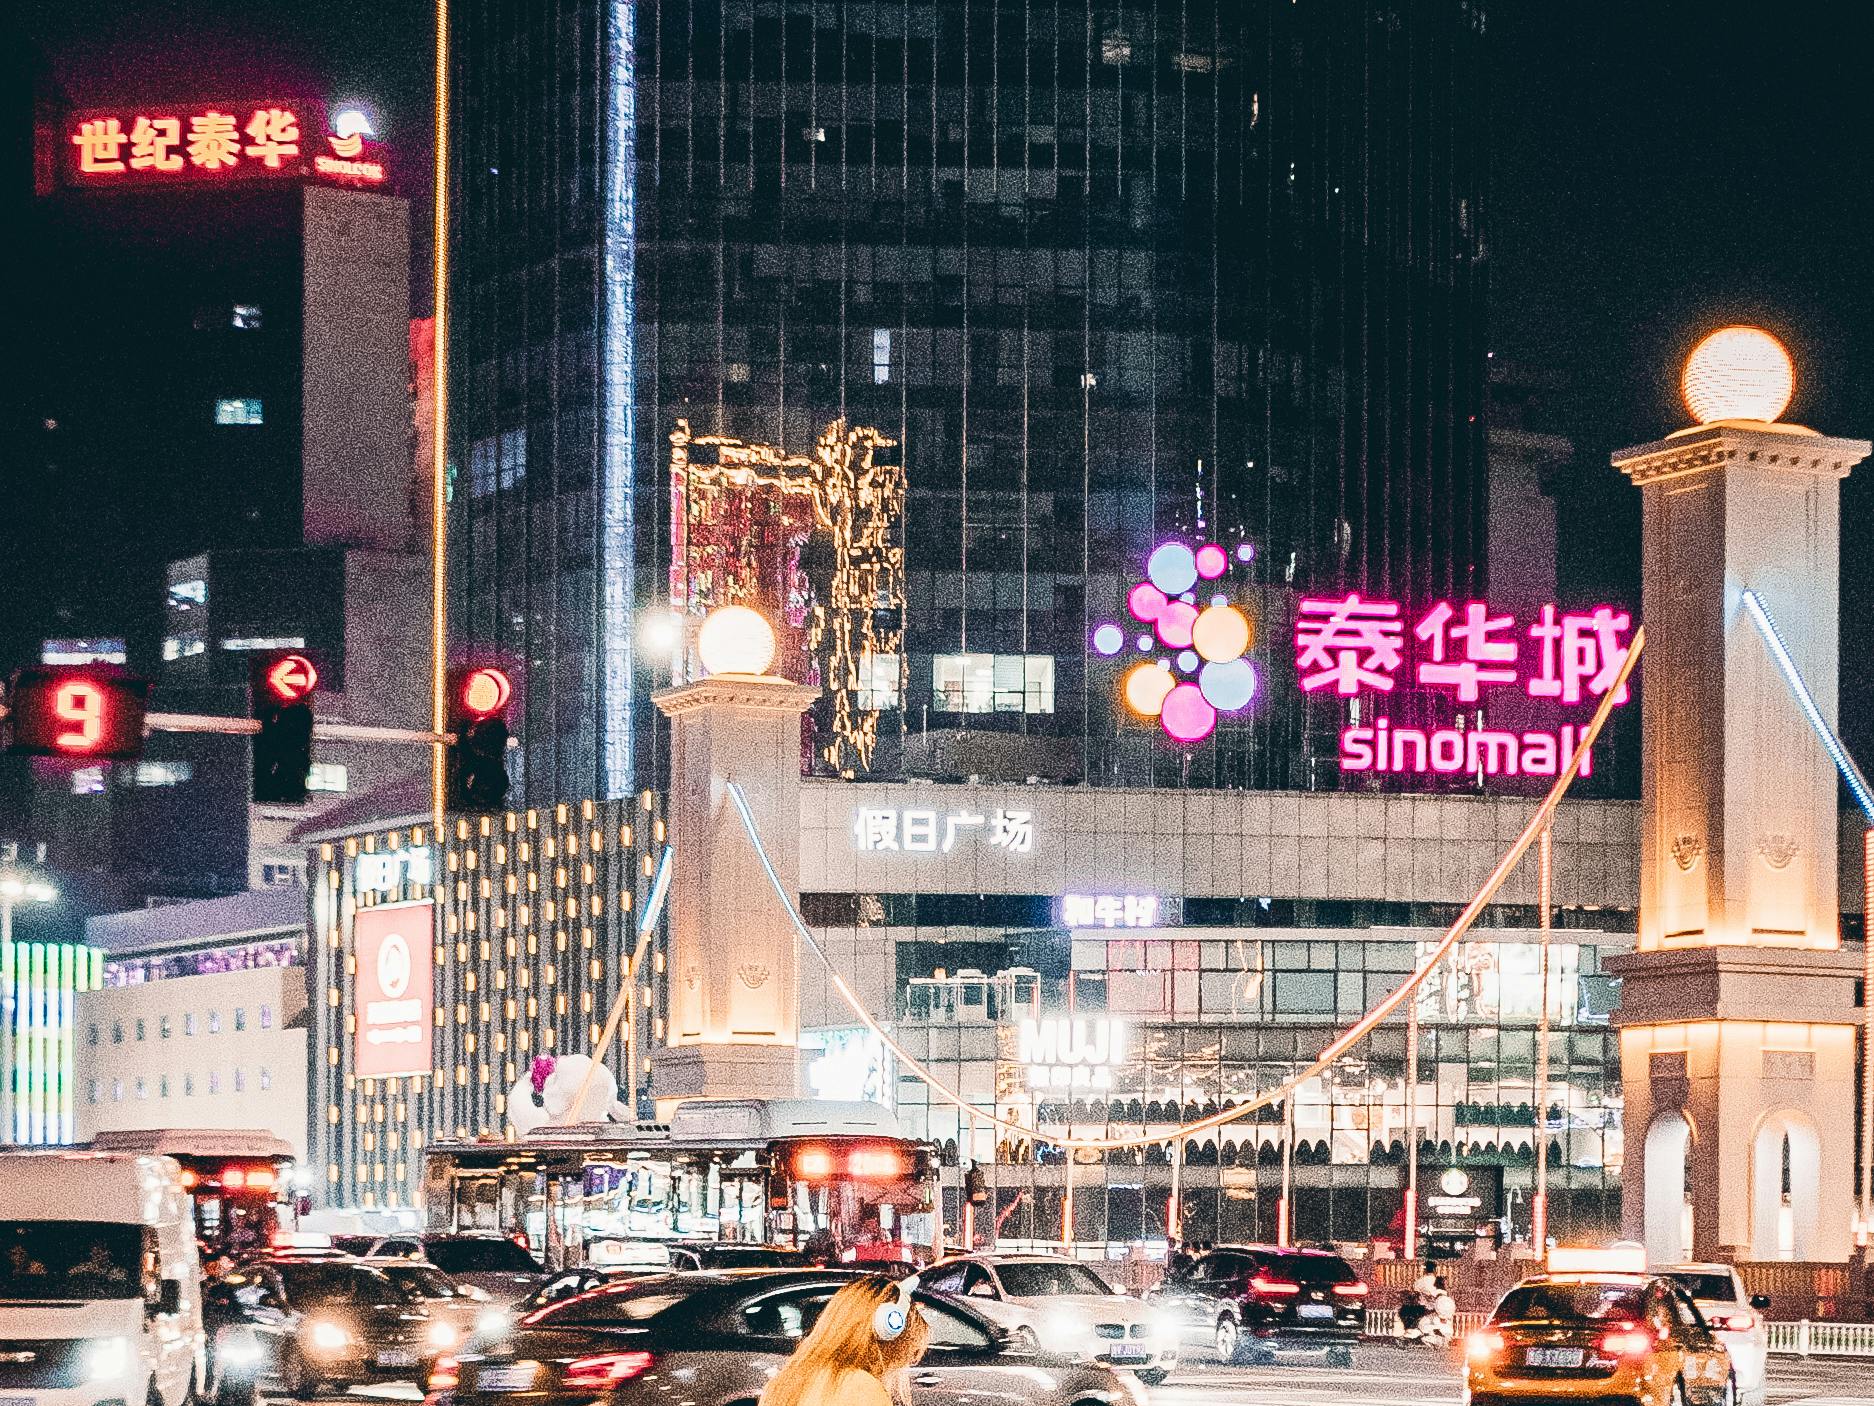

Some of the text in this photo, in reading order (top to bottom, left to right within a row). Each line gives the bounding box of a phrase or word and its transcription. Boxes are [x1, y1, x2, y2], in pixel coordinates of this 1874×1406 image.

[74, 109, 299, 173] 世纪泰华
[1296, 594, 1630, 704] 泰华城
[56, 683, 102, 747] 9
[1341, 718, 1593, 776] sinomall
[854, 807, 1034, 853] 假日广场
[1020, 1019, 1124, 1064] MUJI
